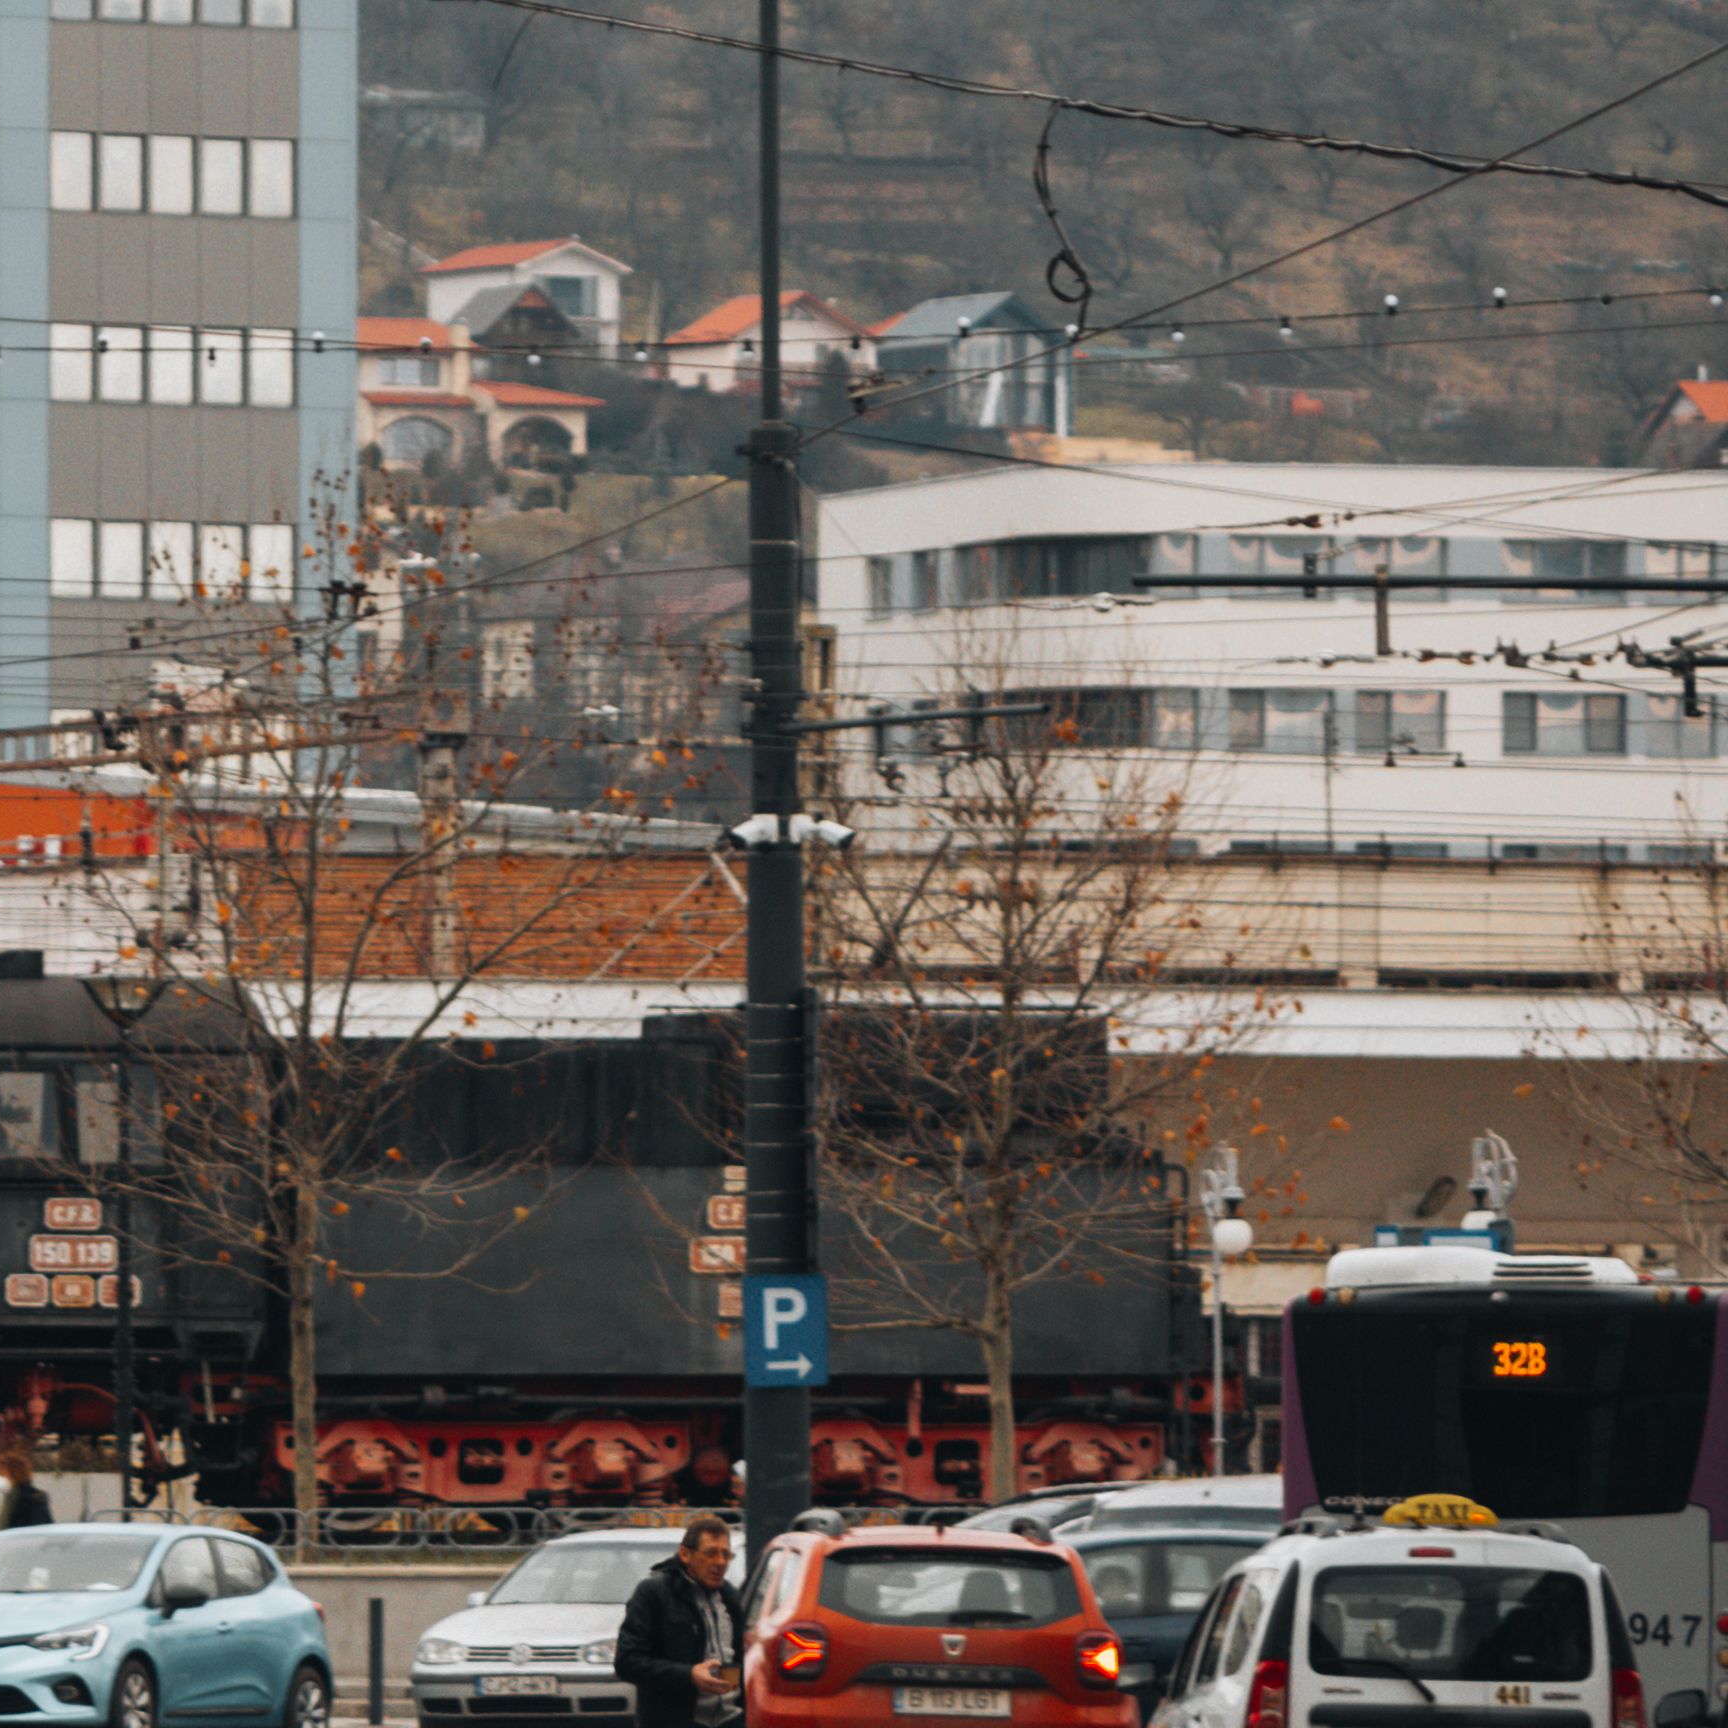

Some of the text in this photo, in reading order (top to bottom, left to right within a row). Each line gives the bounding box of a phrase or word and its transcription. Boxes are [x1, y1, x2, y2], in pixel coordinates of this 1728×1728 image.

[763, 1286, 808, 1349] P
[1416, 1502, 1471, 1521] TAXI
[1495, 1684, 1531, 1705] 441
